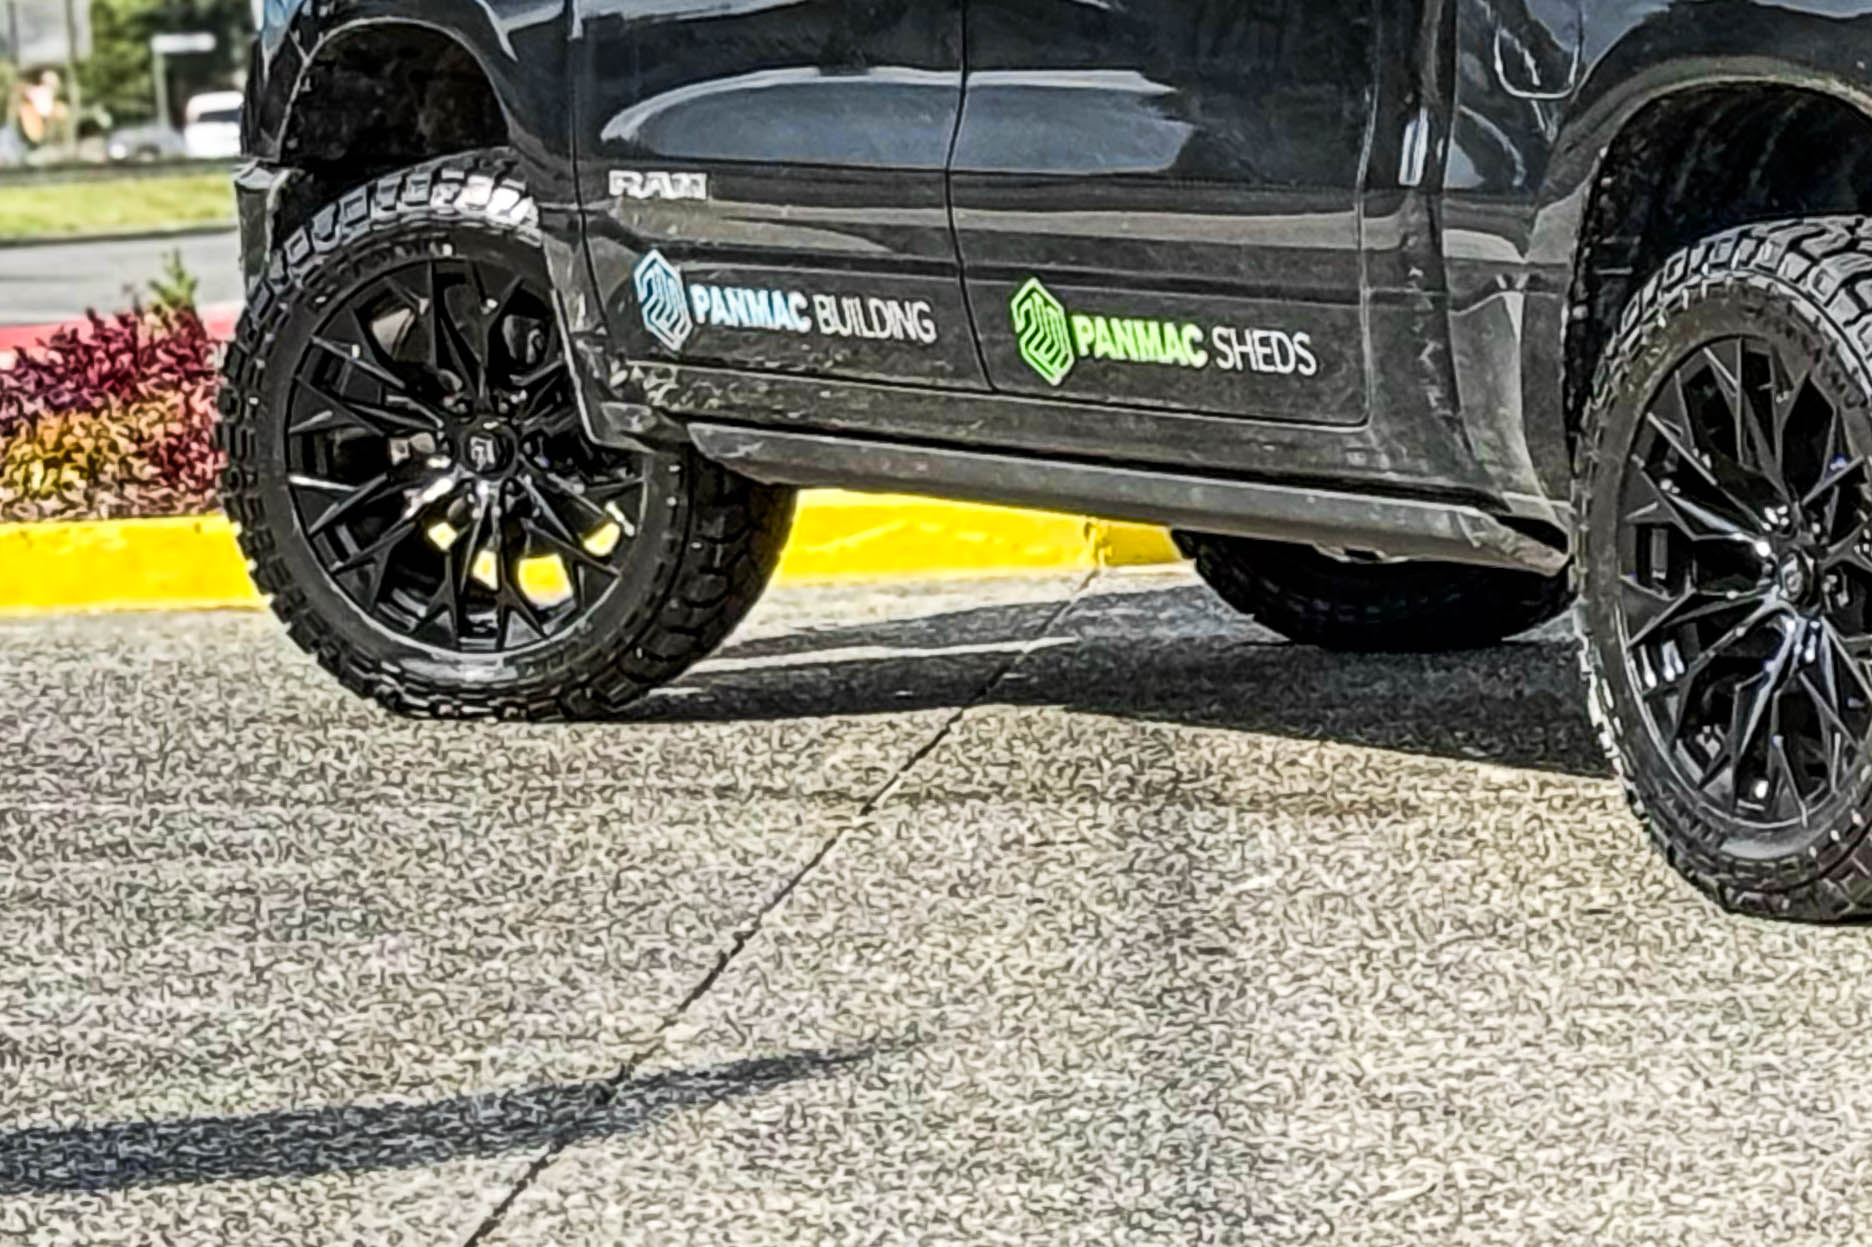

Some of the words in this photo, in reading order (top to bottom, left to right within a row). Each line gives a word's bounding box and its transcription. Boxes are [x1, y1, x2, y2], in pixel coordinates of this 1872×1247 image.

[608, 169, 708, 200] RAM
[691, 283, 813, 333] PANMAC
[814, 294, 938, 345] BUILDING
[1070, 314, 1210, 369] PANMAC
[1212, 326, 1318, 377] SHEDS
